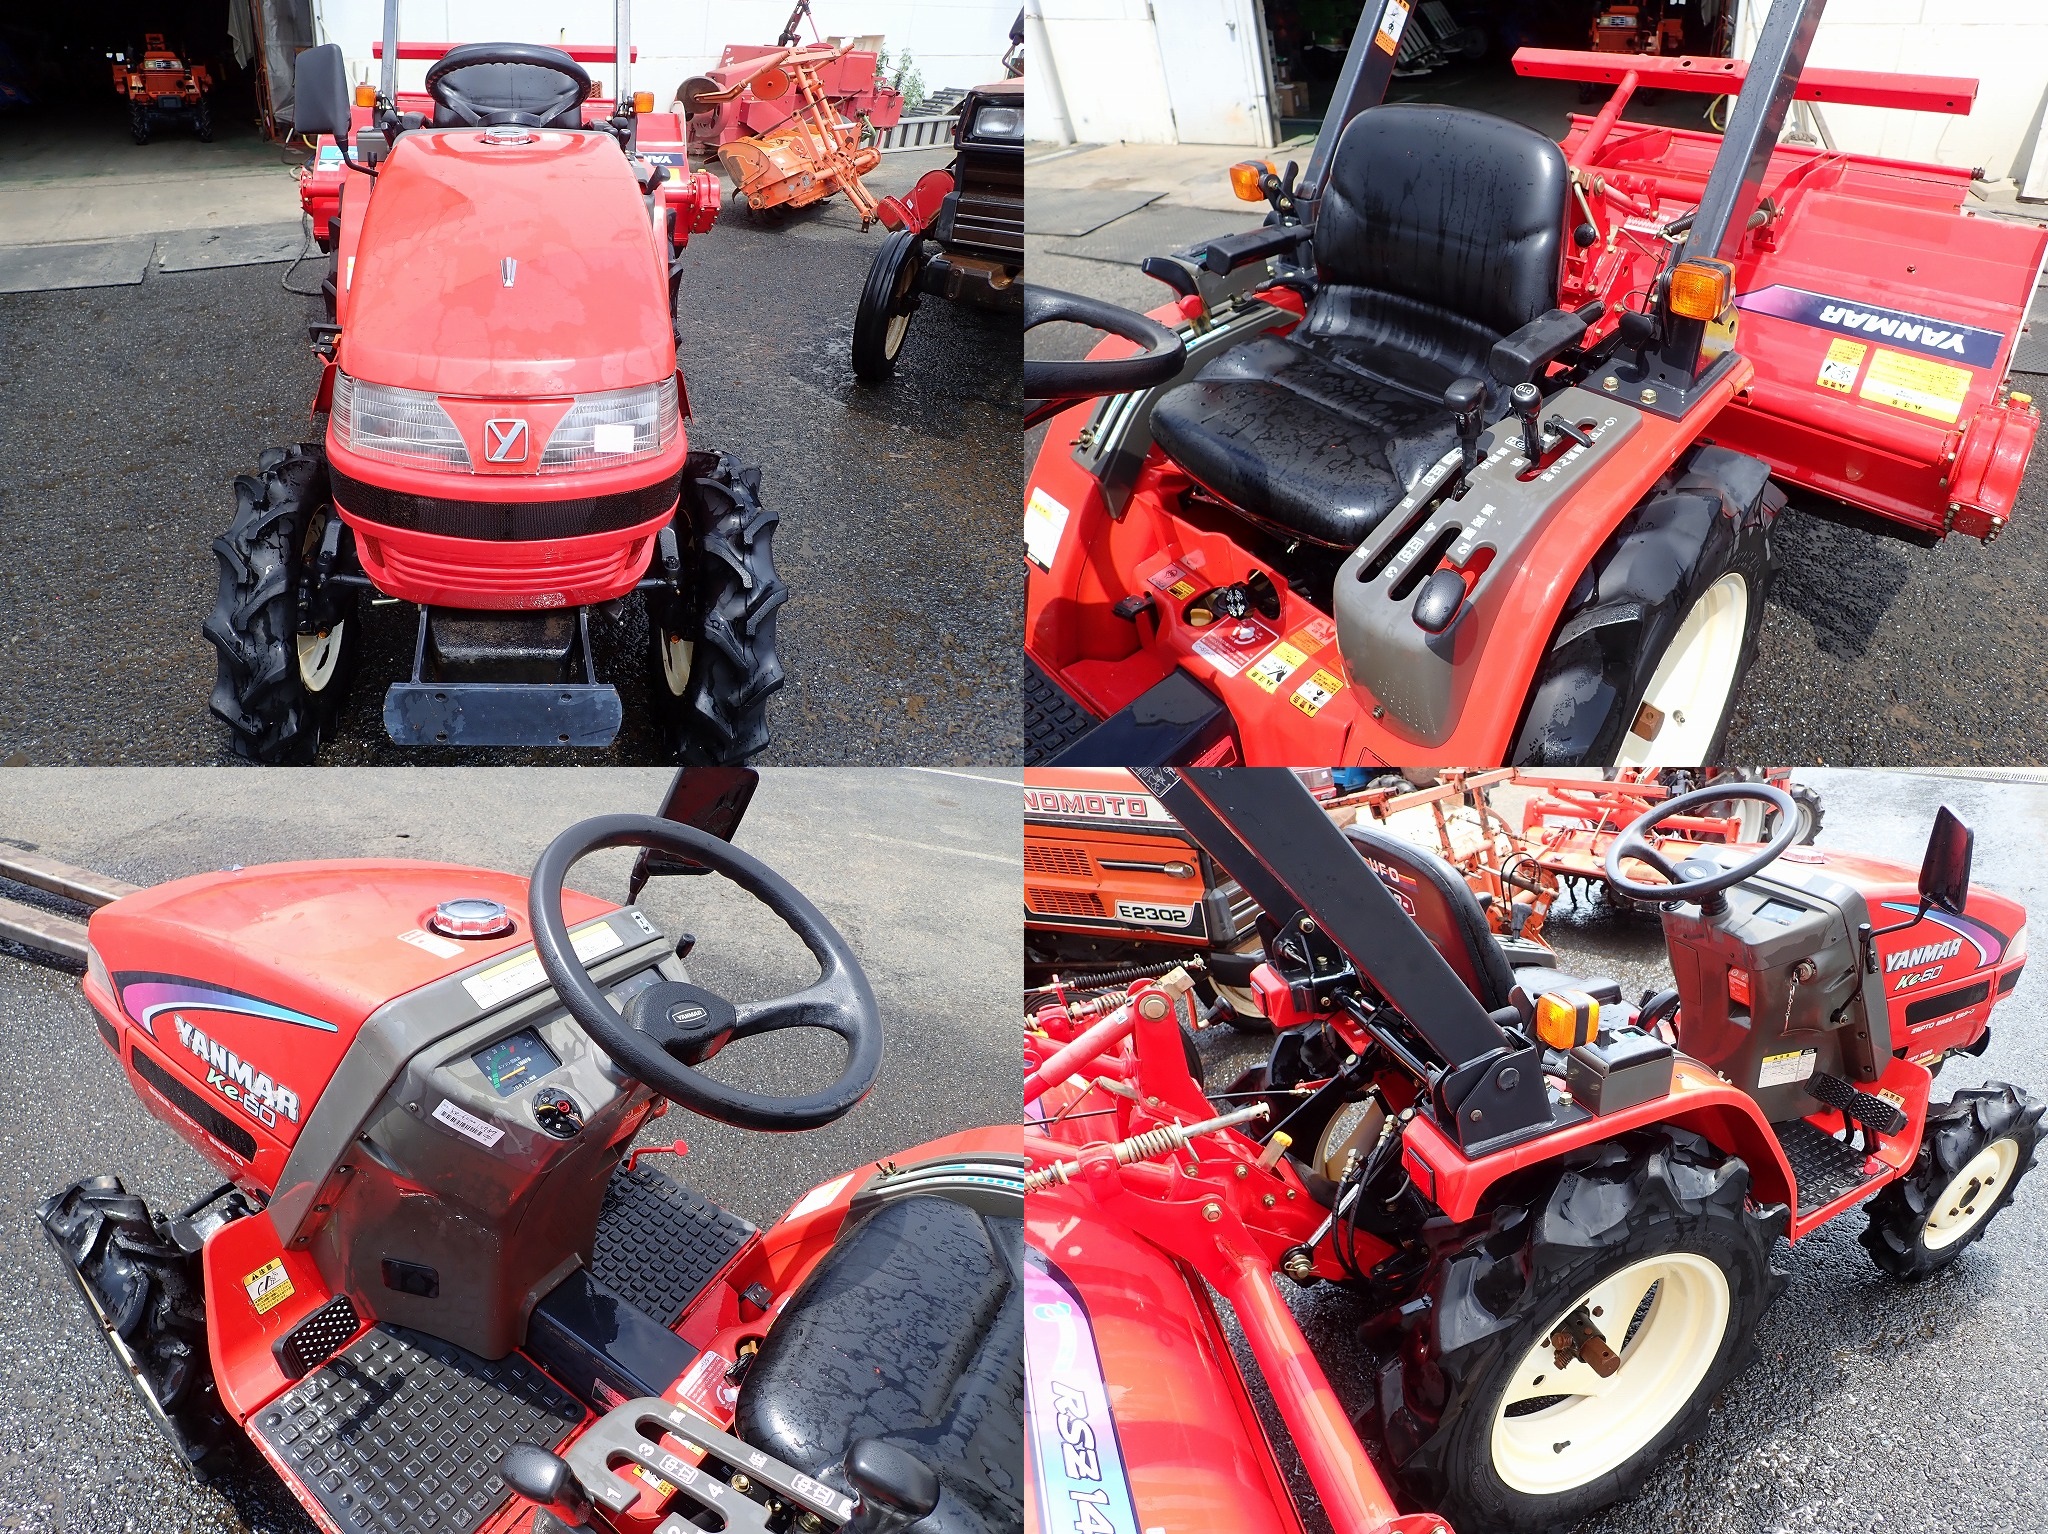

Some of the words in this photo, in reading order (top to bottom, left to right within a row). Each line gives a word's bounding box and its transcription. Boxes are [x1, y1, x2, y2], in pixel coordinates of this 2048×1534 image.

[1818, 304, 1965, 355] YANMAR
[1518, 385, 1533, 395] PTO
[1423, 521, 1437, 532] 4
[1400, 538, 1422, 560] 中立
[1457, 542, 1472, 554] 2
[1384, 565, 1399, 578] 3
[1024, 790, 1148, 819] NOMOTO
[1368, 857, 1400, 883] UFO
[1118, 904, 1188, 923] E2302
[1885, 937, 1964, 974] YANMAR
[676, 1009, 703, 1021] YANMAR
[174, 1013, 301, 1123] YANMAR
[1050, 1380, 1103, 1482] RSZ
[638, 1442, 655, 1458] 3
[749, 1451, 768, 1469] 低
[662, 1457, 696, 1484] 中立
[606, 1487, 622, 1501] 1
[708, 1482, 725, 1499] 4
[797, 1476, 833, 1506] 中立
